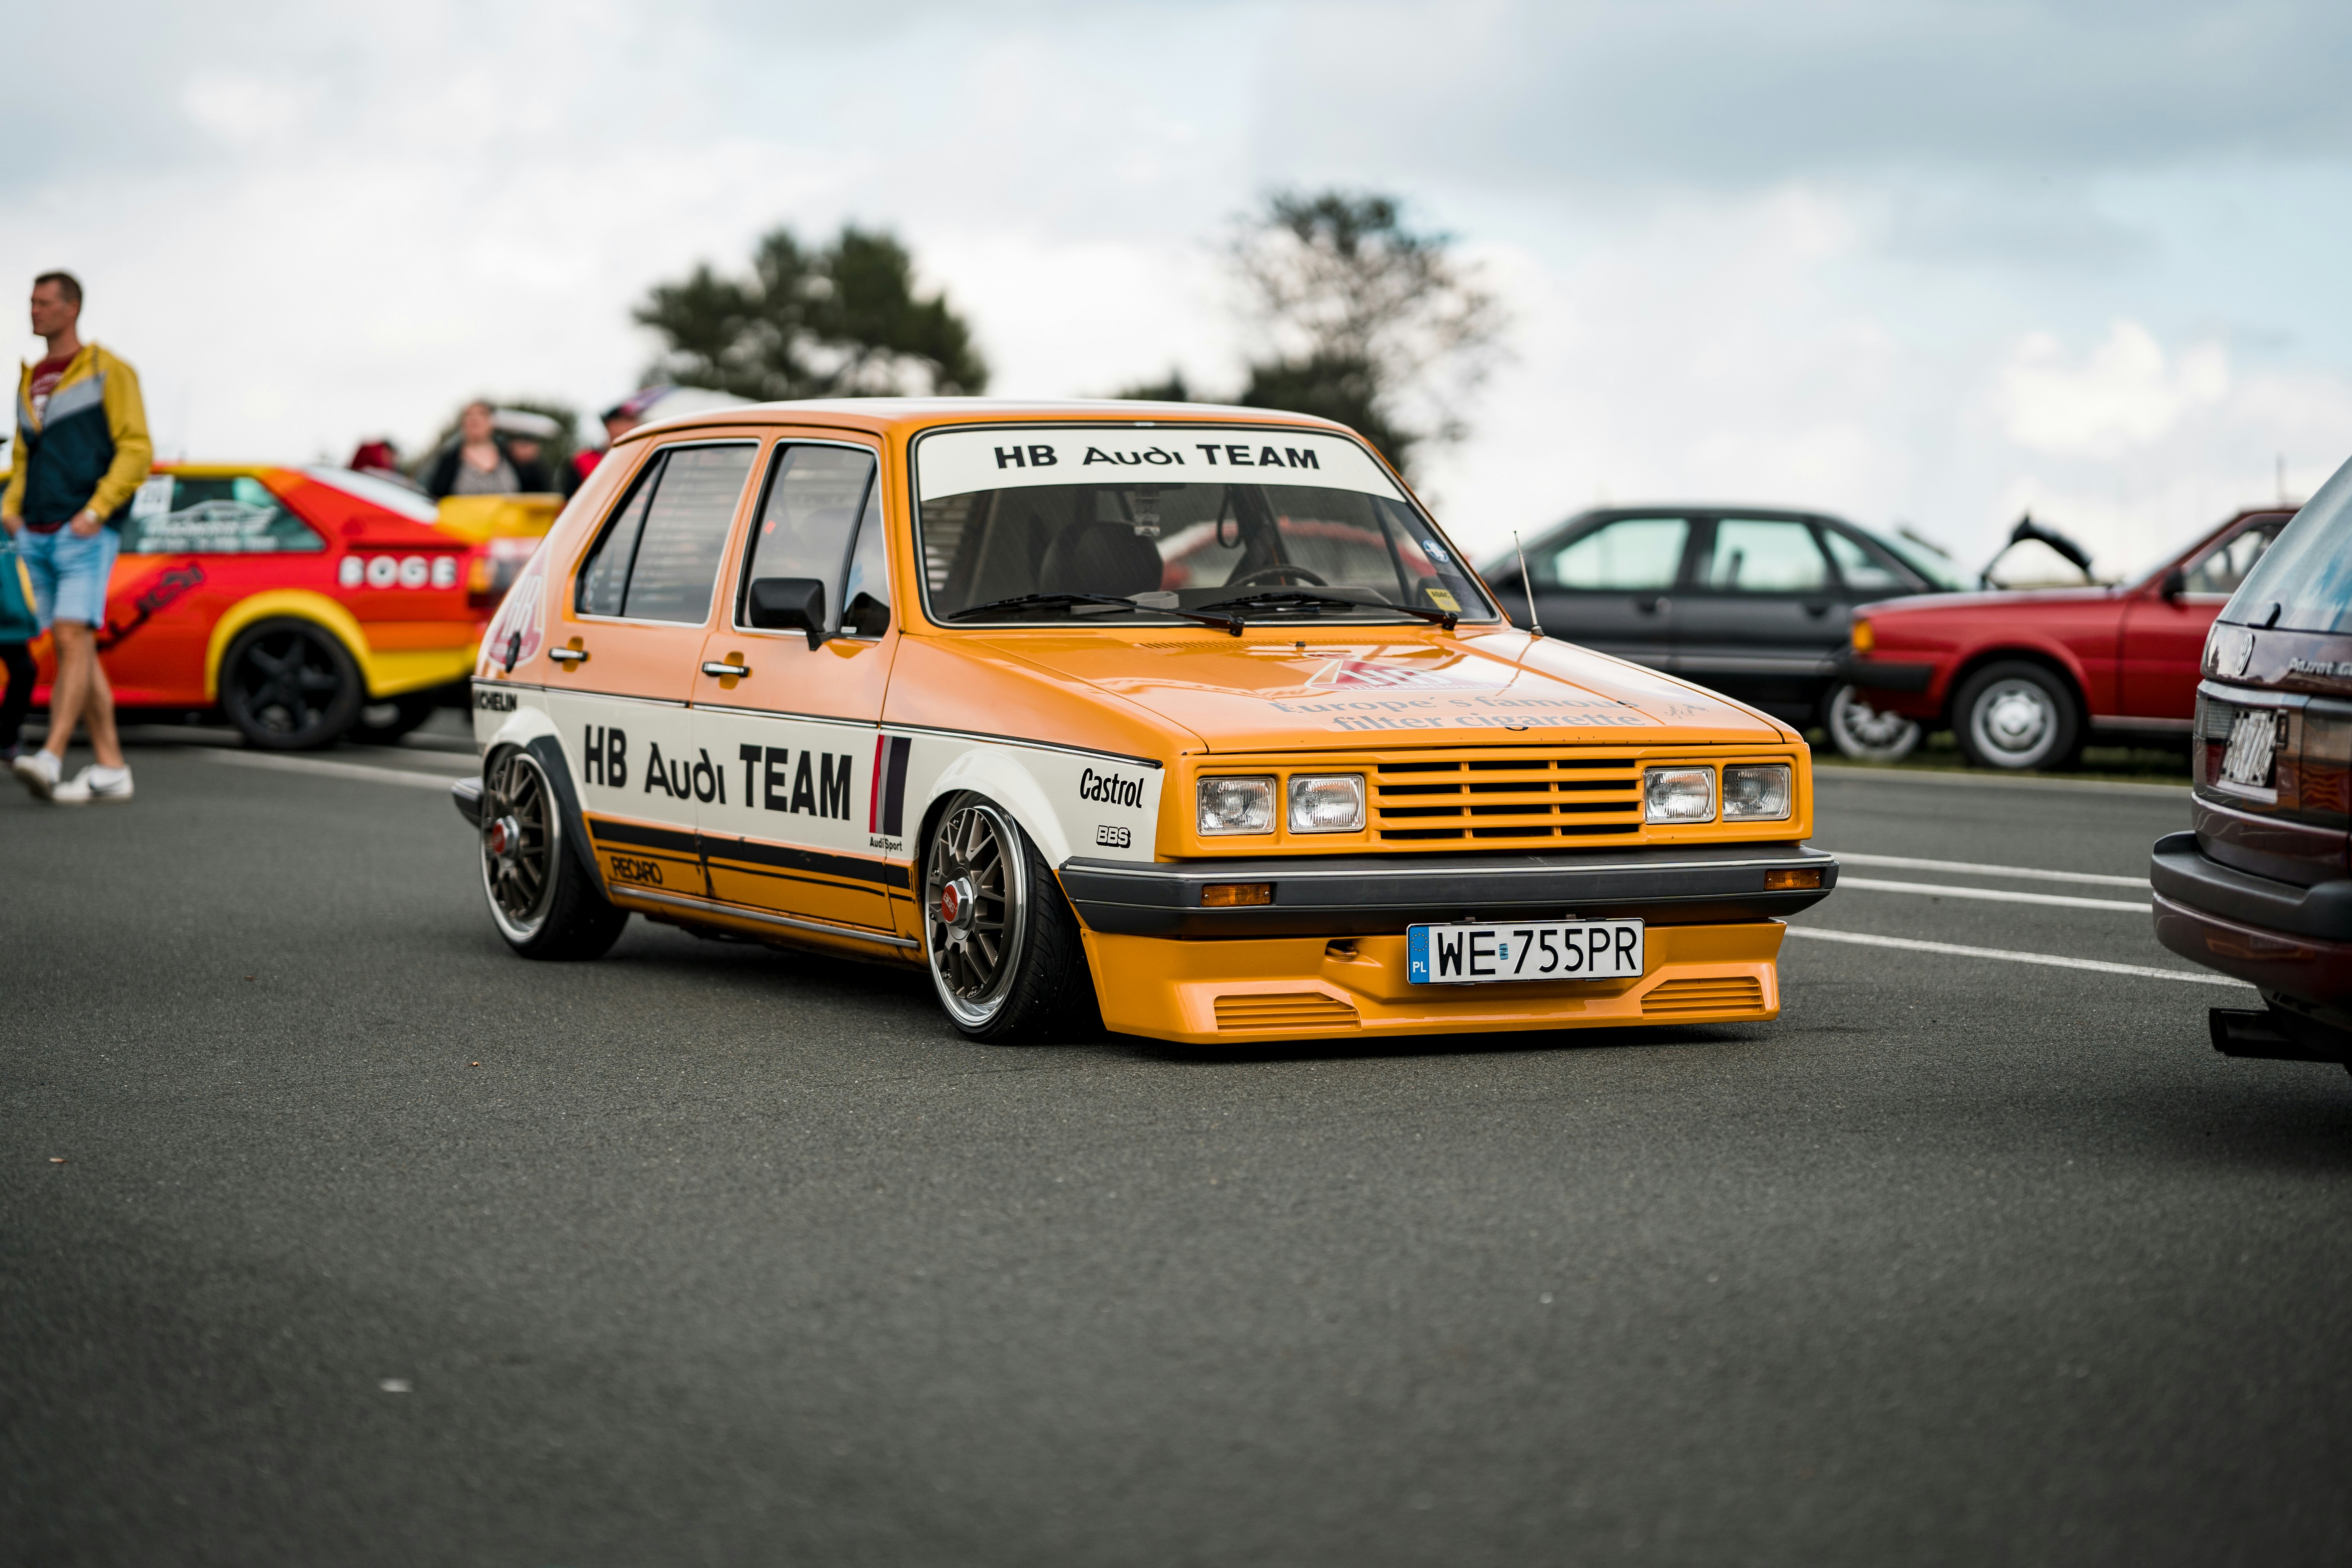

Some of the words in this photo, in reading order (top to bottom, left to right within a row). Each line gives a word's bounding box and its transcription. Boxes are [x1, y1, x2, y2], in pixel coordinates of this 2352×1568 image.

[994, 445, 1057, 469] HB
[1082, 447, 1185, 465] Audi
[1196, 444, 1320, 469] TEAM
[338, 554, 457, 589] BOGE
[1337, 669, 1453, 685] HB
[1343, 682, 1492, 690] international
[473, 690, 517, 712] ICHELIN
[1474, 697, 1639, 708] famous
[1332, 715, 1443, 730] filter
[1455, 713, 1646, 731] cigarette
[584, 724, 627, 788] HB
[644, 742, 726, 805] Audi
[739, 744, 853, 821] TEAM
[1080, 768, 1144, 809] Castrol
[1096, 825, 1131, 849] BBS
[611, 856, 663, 884] RECARO
[943, 892, 956, 913] BBS
[1437, 931, 1496, 976] WE
[1513, 927, 1637, 974] 755PR
[1412, 961, 1426, 973] PL
